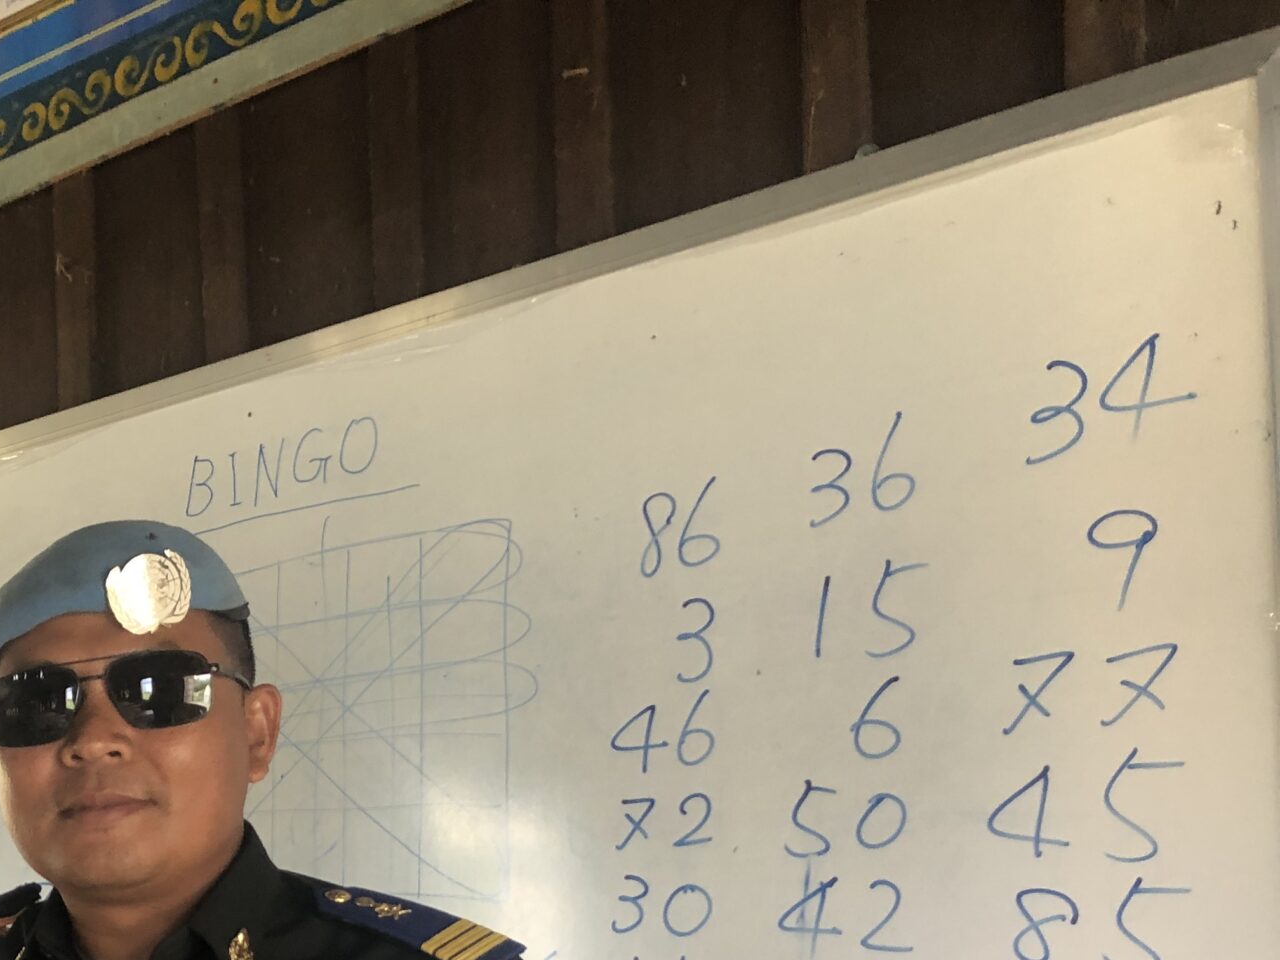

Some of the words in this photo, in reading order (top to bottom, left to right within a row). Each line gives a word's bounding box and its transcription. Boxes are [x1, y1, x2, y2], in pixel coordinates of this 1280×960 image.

[1026, 332, 1198, 465] 34
[185, 416, 379, 518] BINGO
[809, 411, 917, 528] 36
[640, 475, 721, 578] 86
[1086, 508, 1158, 612] 9
[676, 597, 715, 684] 3
[815, 558, 929, 659] 15
[610, 688, 716, 775] 46
[849, 675, 902, 760] 6
[1001, 642, 1178, 736] 77
[615, 792, 713, 850] 72
[784, 779, 907, 858] 50
[986, 746, 1186, 863] 45
[610, 874, 713, 937] 30
[778, 875, 914, 960] 42
